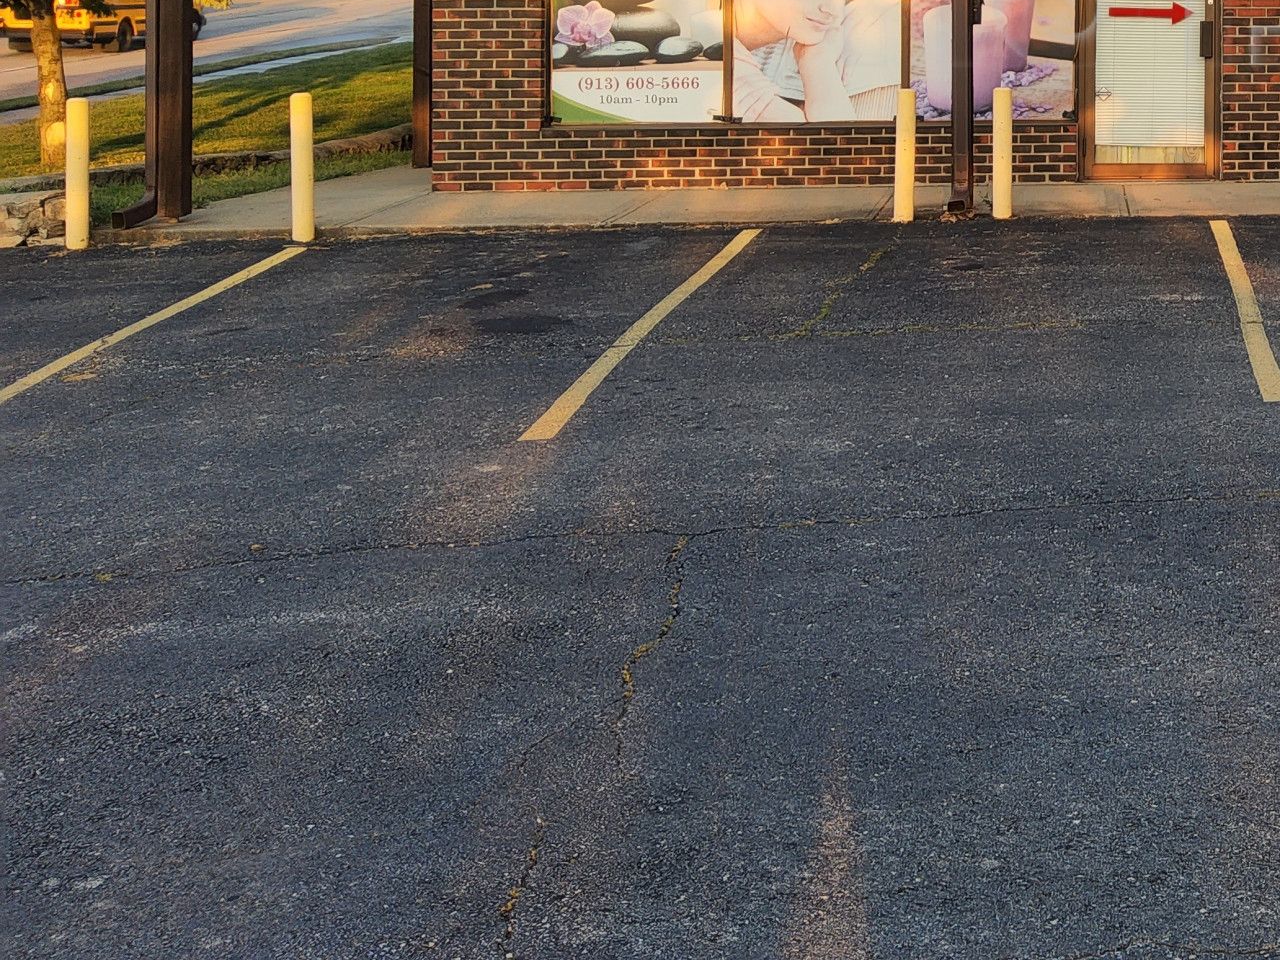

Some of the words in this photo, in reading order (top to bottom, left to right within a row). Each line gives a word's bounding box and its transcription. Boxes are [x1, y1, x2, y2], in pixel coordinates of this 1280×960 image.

[577, 77, 620, 92] (913)
[625, 76, 700, 90] 608-5666
[599, 95, 633, 104] 10am
[644, 94, 679, 106] 10pm
